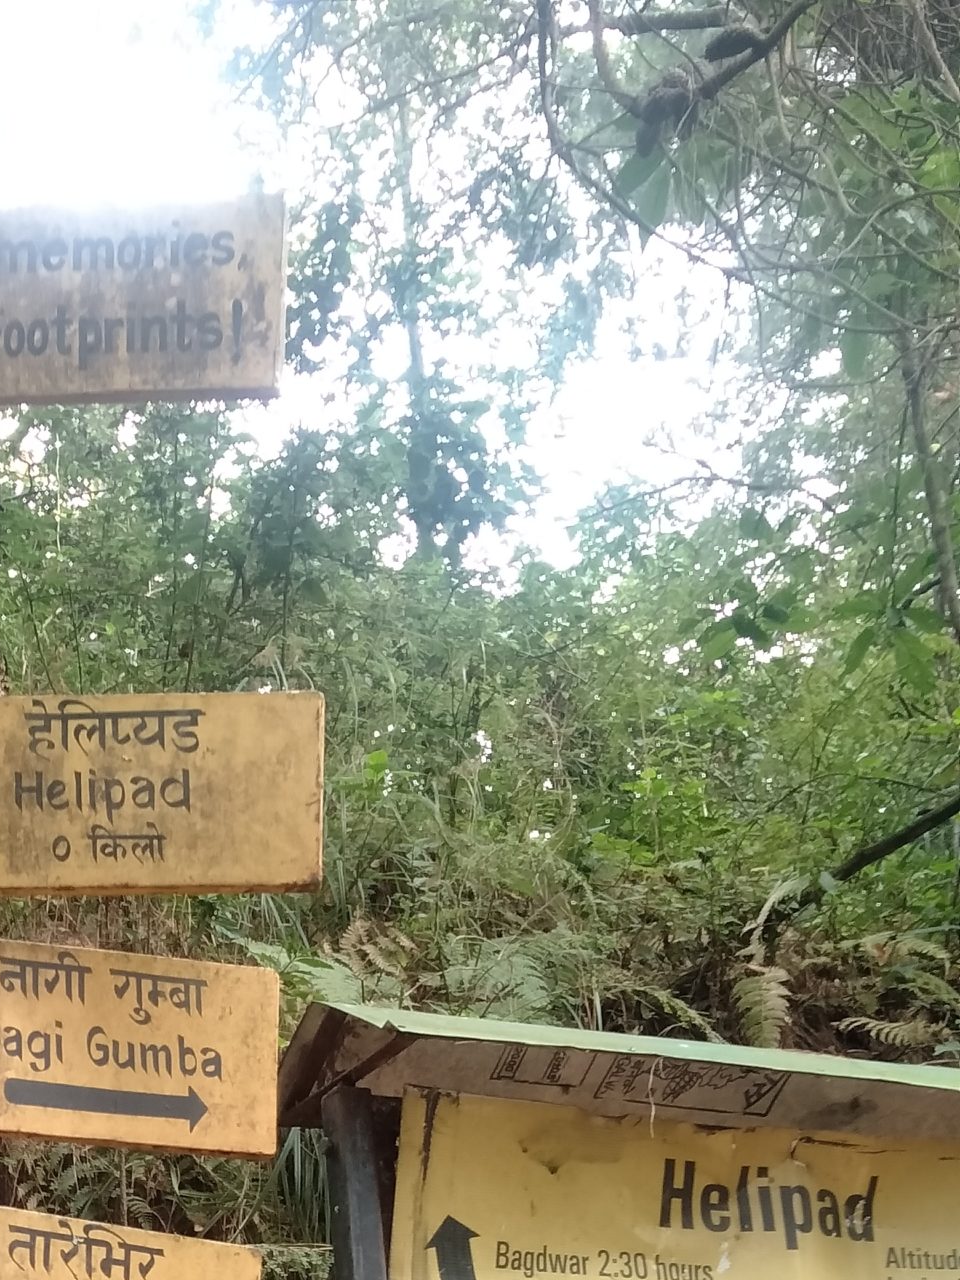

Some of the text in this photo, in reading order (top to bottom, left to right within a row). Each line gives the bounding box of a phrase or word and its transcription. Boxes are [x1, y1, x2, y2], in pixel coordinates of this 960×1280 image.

[14, 769, 191, 823] Helipad
[88, 822, 167, 864] किलो
[0, 951, 208, 1025] नागी गुम्बा
[86, 1025, 223, 1081] Gumba
[659, 1158, 879, 1250] Helipad
[495, 1241, 589, 1279] Bagdwar
[598, 1250, 648, 1280] 2:30
[885, 1247, 960, 1270] Altitud
